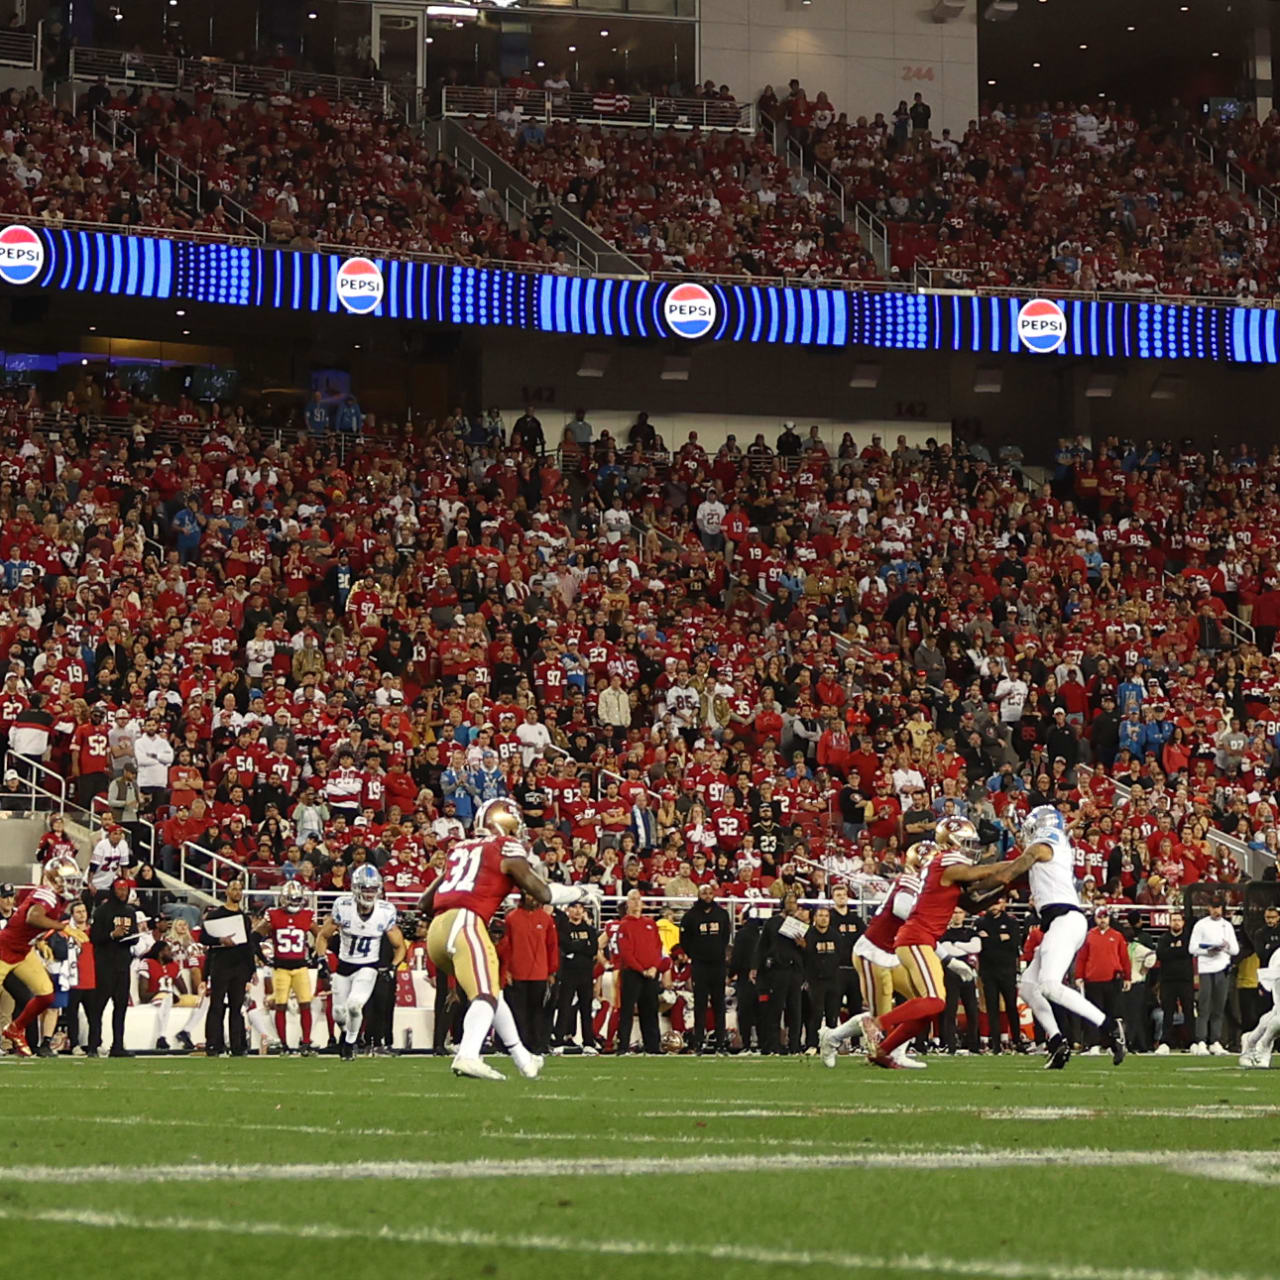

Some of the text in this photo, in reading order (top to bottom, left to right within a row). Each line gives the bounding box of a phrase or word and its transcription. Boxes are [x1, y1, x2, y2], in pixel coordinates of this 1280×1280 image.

[340, 275, 382, 291] PEPSI
[669, 304, 711, 318] PEPSI
[1021, 320, 1063, 333] PEPSI
[800, 473, 813, 484] 23
[732, 521, 743, 532] 13
[749, 548, 762, 559] 19
[768, 568, 782, 581] 97
[362, 602, 374, 615] 97
[590, 648, 606, 662] 23
[1126, 651, 1137, 666] 19
[69, 666, 83, 681] 19
[547, 671, 561, 685] 97
[675, 695, 692, 710] 85
[90, 738, 106, 754] 52
[499, 743, 516, 757] 85
[237, 756, 252, 770] 54
[368, 782, 382, 800] 19
[708, 783, 724, 800] 97
[718, 818, 738, 835] 52
[1141, 824, 1152, 835] 11
[760, 836, 777, 852] 23
[1090, 854, 1104, 866] 85
[438, 846, 483, 892] 31
[1154, 914, 1170, 926] 141
[277, 929, 305, 953] 53
[348, 934, 371, 957] 14
